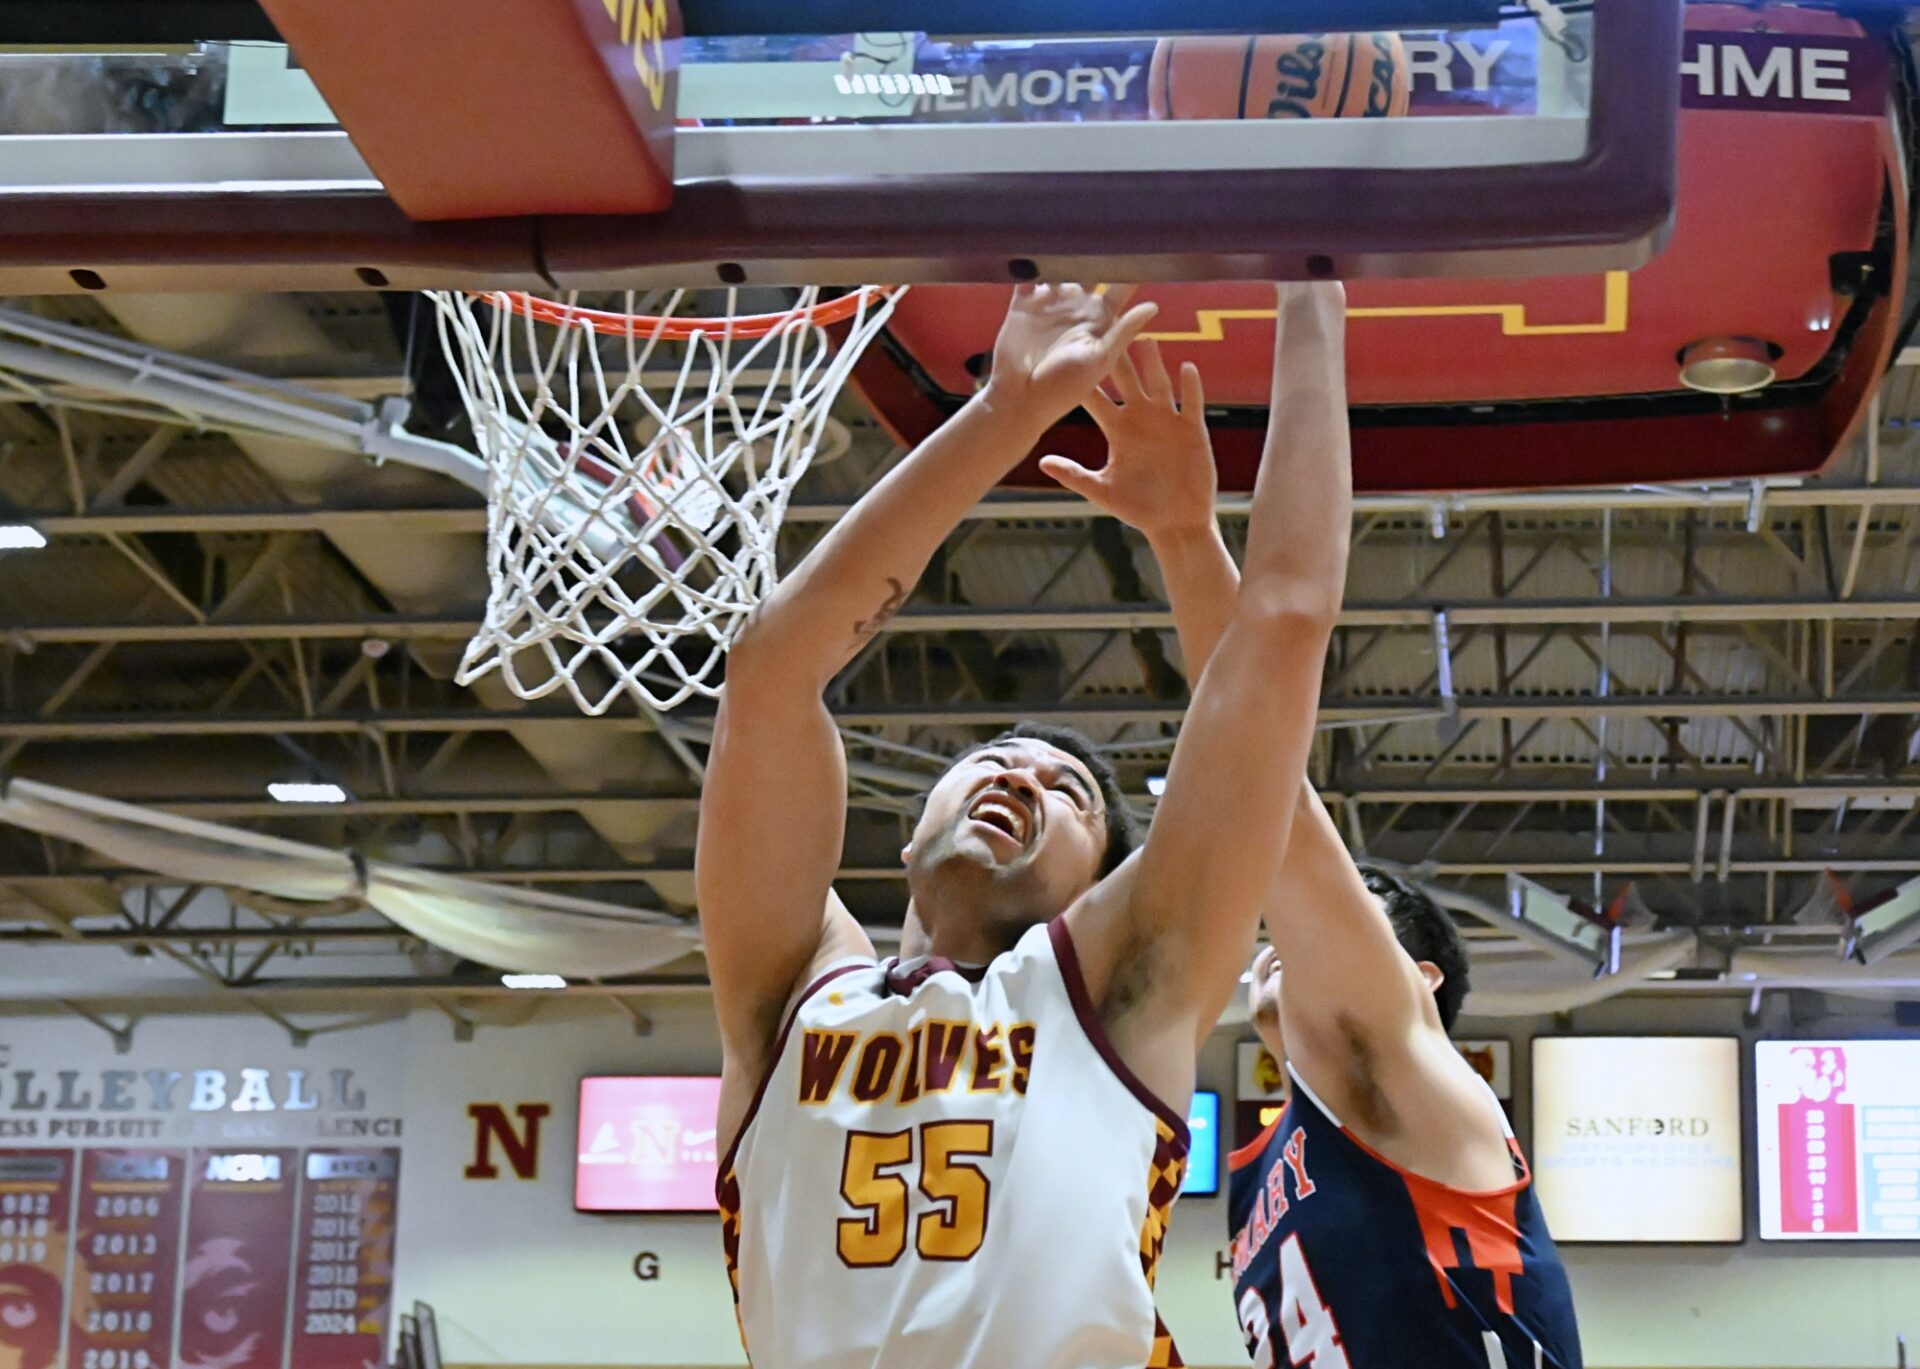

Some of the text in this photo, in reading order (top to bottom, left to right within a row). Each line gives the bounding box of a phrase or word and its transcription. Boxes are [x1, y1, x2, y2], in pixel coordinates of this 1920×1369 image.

[798, 1017, 1037, 1107] WOLVES
[0, 1069, 366, 1112] LLEYBALL
[49, 1118, 163, 1138] PURSUIT
[463, 1102, 551, 1181] N
[1566, 1117, 1710, 1138] SANFORD
[836, 1119, 994, 1269] 55
[90, 1271, 154, 1293] 2017
[633, 1252, 660, 1281] G
